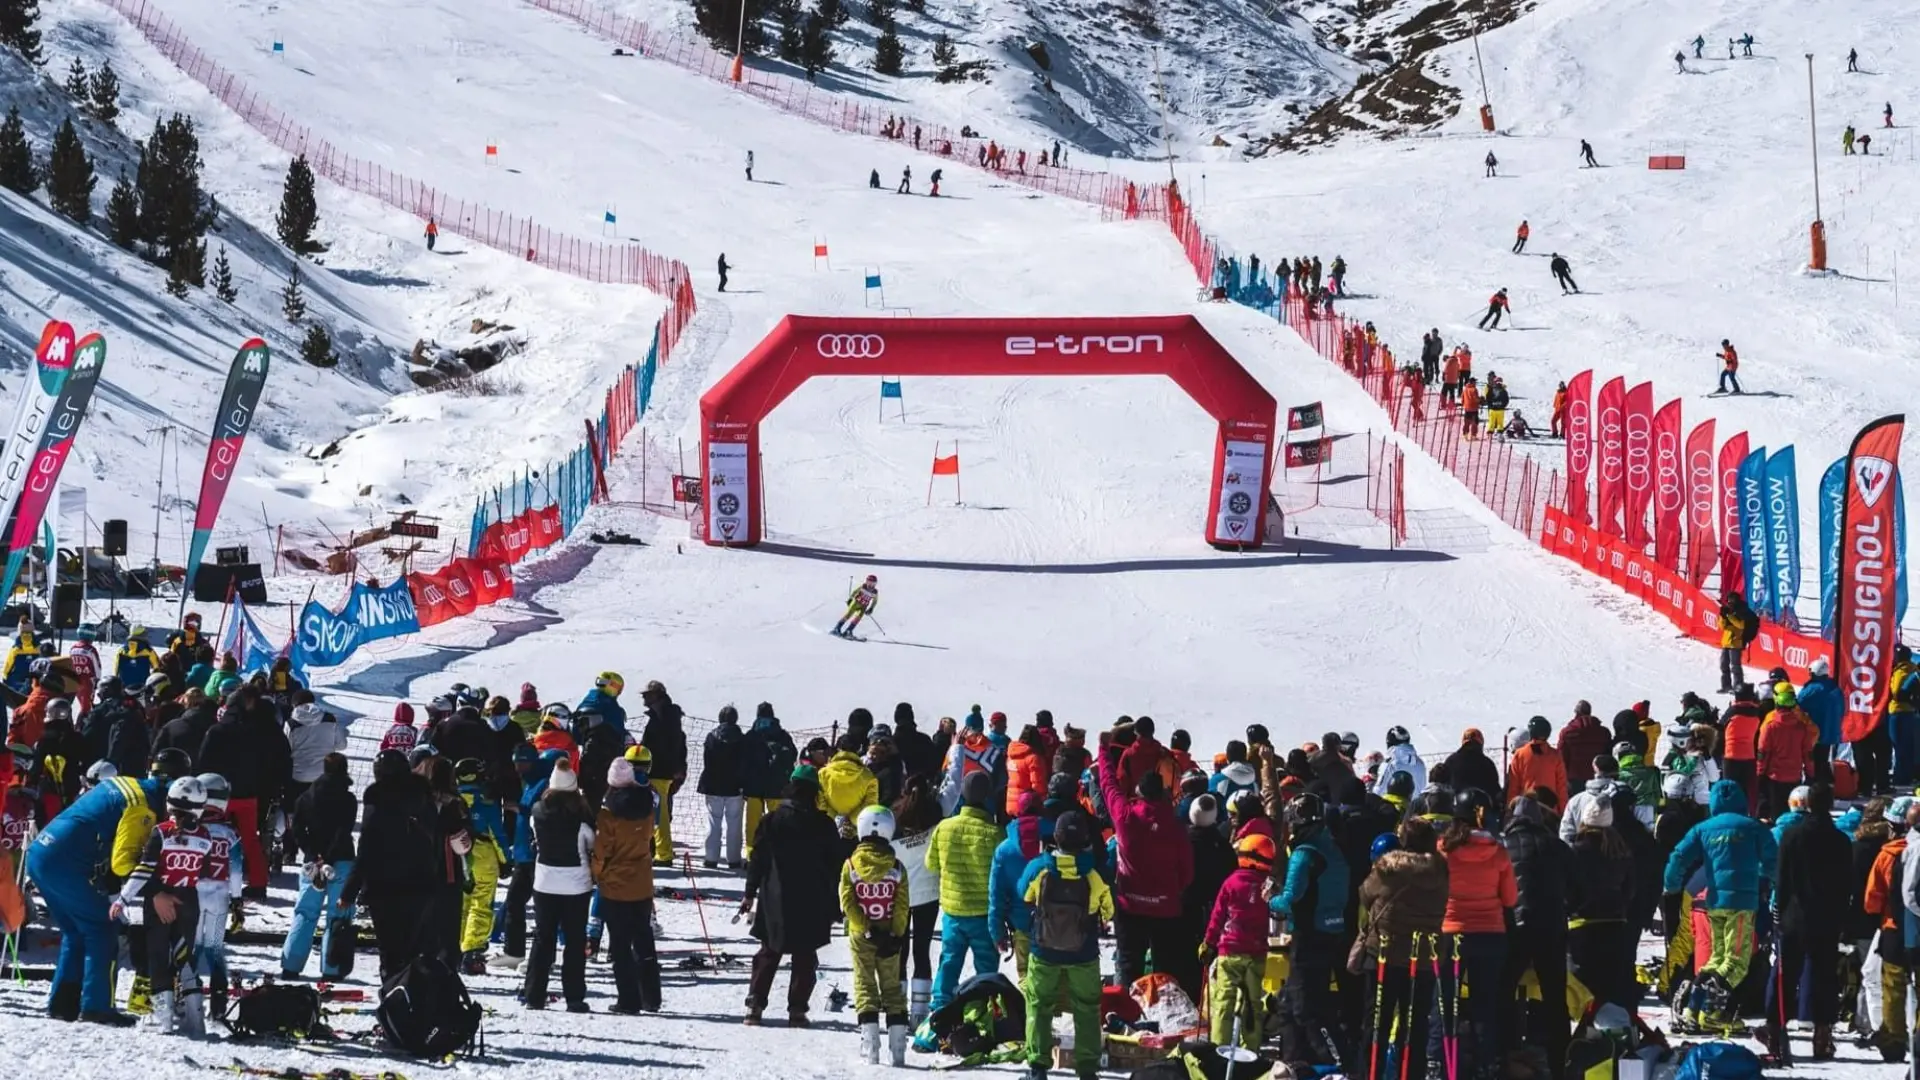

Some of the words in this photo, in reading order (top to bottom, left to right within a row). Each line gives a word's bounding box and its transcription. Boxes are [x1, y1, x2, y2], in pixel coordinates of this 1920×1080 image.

[1005, 334, 1164, 355] e-tron
[31, 397, 80, 494] cerler
[210, 393, 250, 481] cerler
[1744, 477, 1765, 603] SPAINSNOW
[1769, 477, 1795, 608] SPAINSNOW
[1849, 514, 1884, 714] ROSSIGNOL
